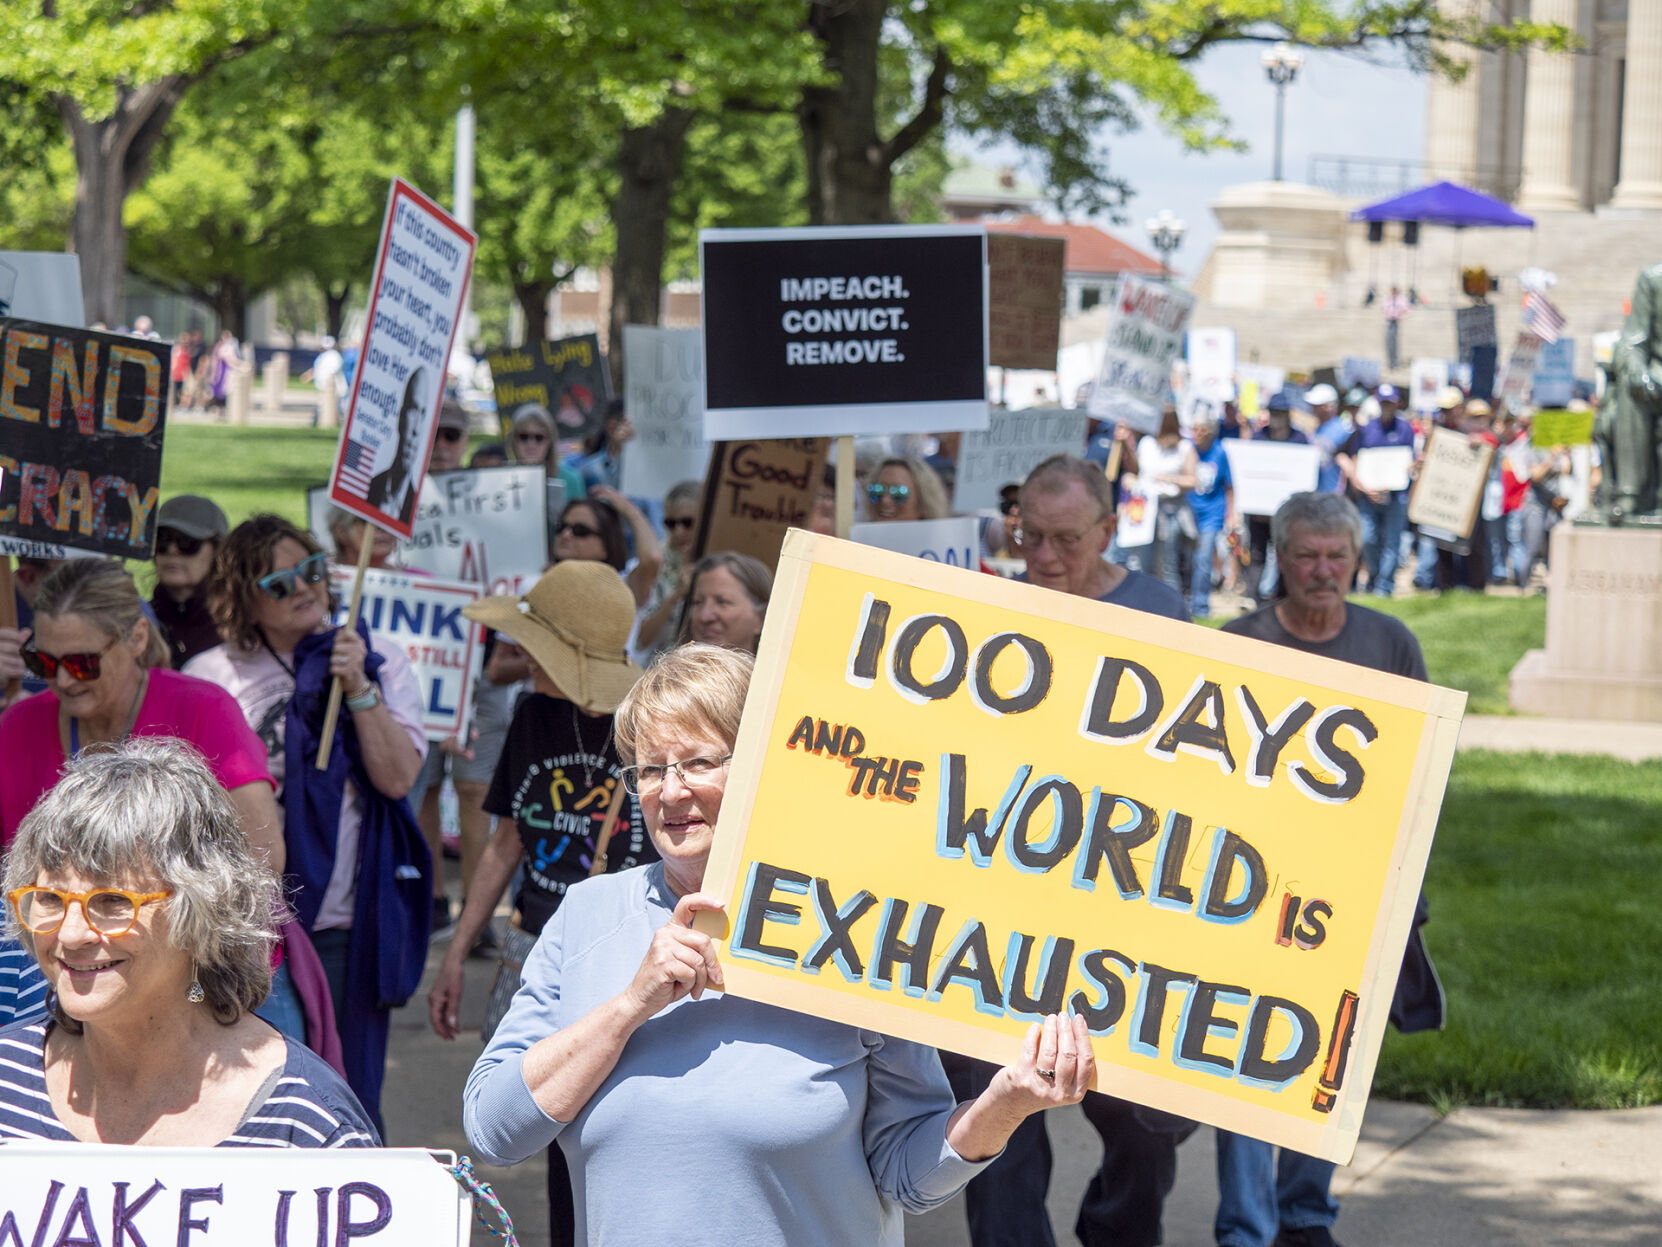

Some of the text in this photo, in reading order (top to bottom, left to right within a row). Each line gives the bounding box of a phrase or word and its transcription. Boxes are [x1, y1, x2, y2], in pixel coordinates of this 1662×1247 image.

[396, 201, 462, 272] If this country
[389, 236, 452, 297] hasn't broken
[780, 275, 911, 302] IMPEACH.
[378, 274, 406, 301] your
[431, 311, 450, 336] you
[781, 307, 910, 334] CONVICT.
[368, 340, 390, 371] love
[373, 309, 444, 370] probably don't
[541, 338, 593, 373] Lying
[786, 338, 905, 366] REMOVE.
[730, 443, 814, 490] Good
[445, 474, 526, 515] First
[725, 480, 807, 525] Trouble
[407, 645, 466, 669] STILL
[844, 591, 1379, 805] 100 DAYS
[543, 752, 607, 770] VIOLENCE
[553, 811, 592, 837] CIVIC
[785, 714, 1336, 952] AND THE WORLD IS
[728, 859, 1361, 1114] EXHAUSTED!
[0, 1178, 393, 1247] WAKE UP
